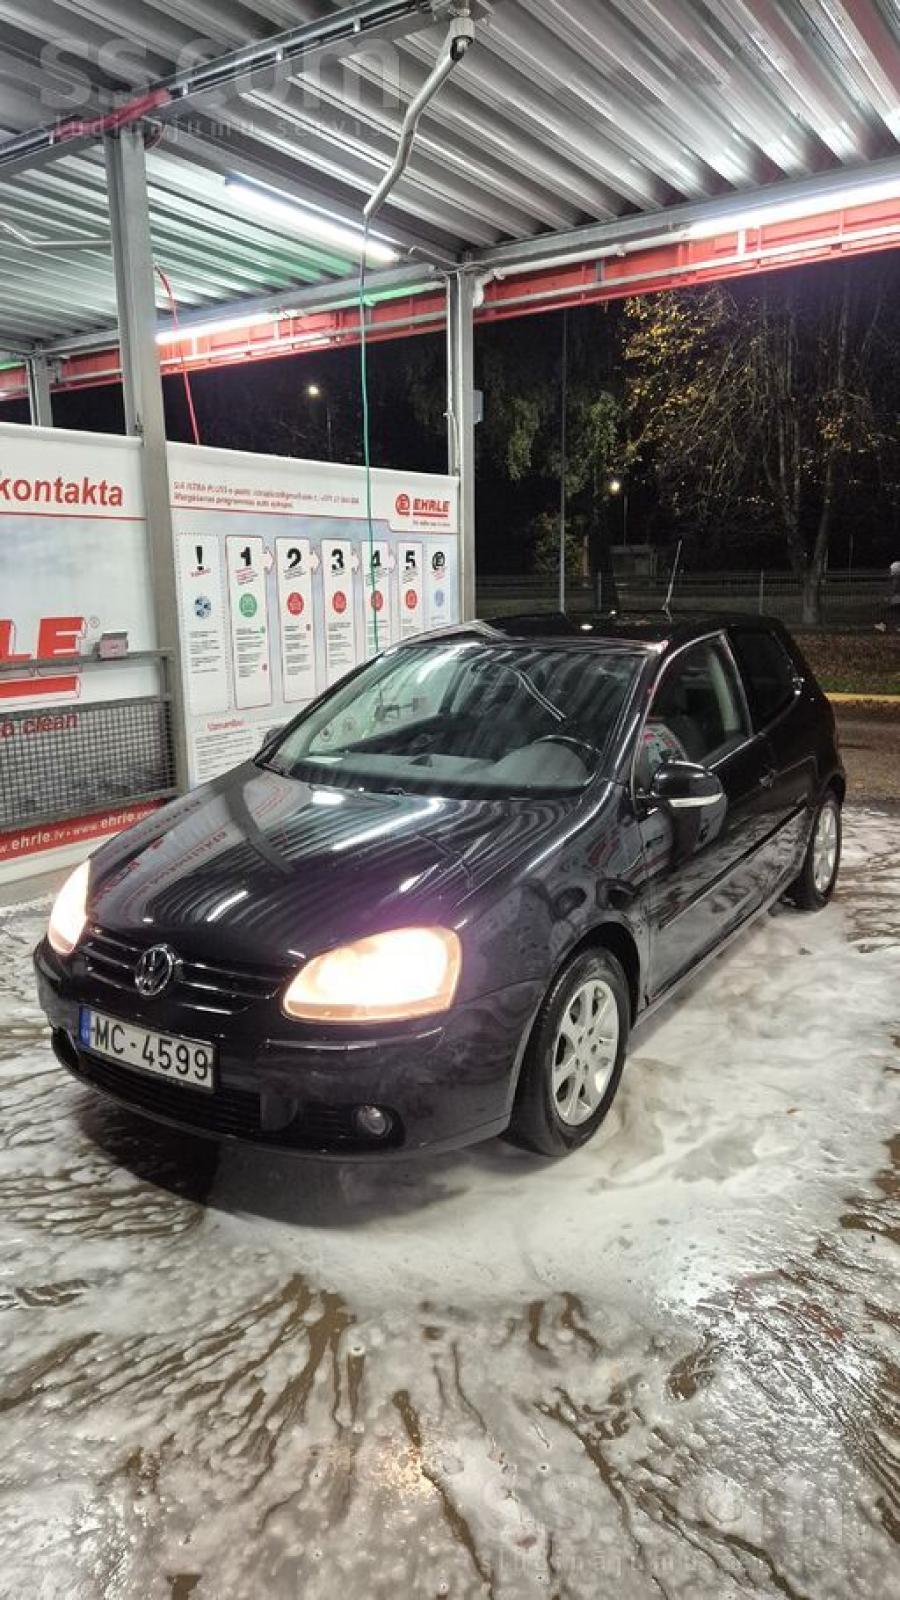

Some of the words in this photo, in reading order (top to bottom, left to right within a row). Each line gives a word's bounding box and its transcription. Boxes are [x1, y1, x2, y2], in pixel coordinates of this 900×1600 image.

[413, 498, 450, 512] EHRLE
[240, 546, 251, 567] 1
[286, 547, 302, 569] 2
[331, 548, 344, 570] 3
[405, 550, 416, 570] 5
[23, 713, 78, 734] clean
[96, 1016, 209, 1081] MC-4599
